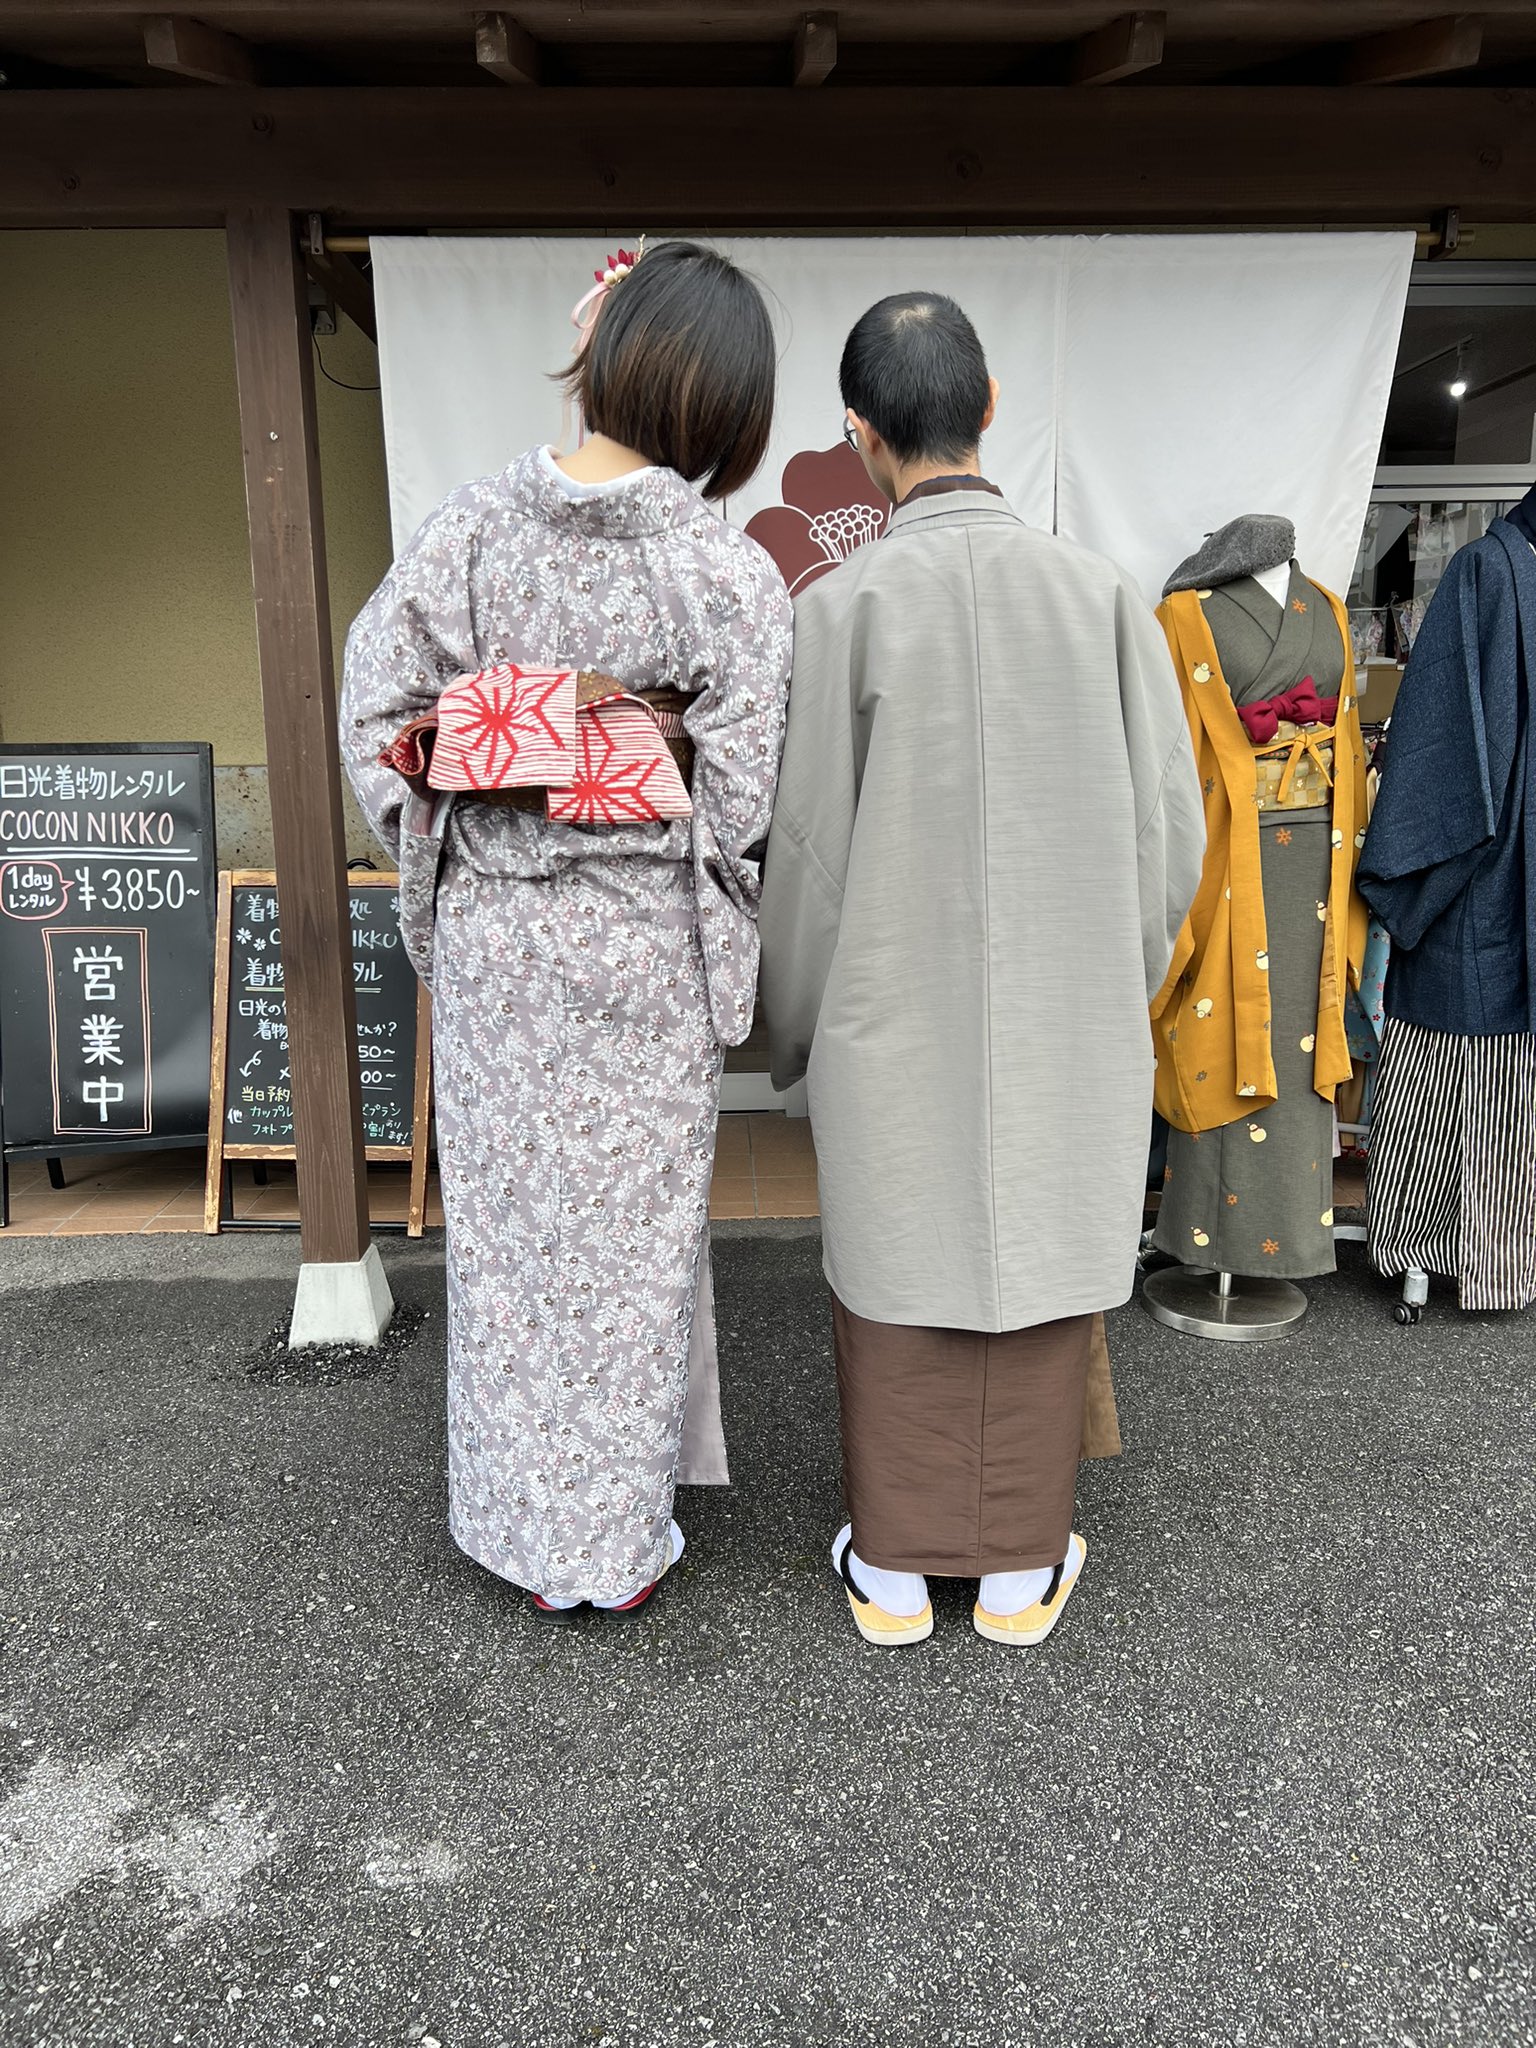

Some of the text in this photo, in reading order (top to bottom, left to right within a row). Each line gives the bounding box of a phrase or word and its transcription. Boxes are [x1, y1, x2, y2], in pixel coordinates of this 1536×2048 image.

[0, 764, 186, 800] 日光着物レンタル
[0, 809, 174, 845] COCON NIKKO
[9, 894, 56, 908] レンタル
[73, 945, 125, 1122] 営業中
